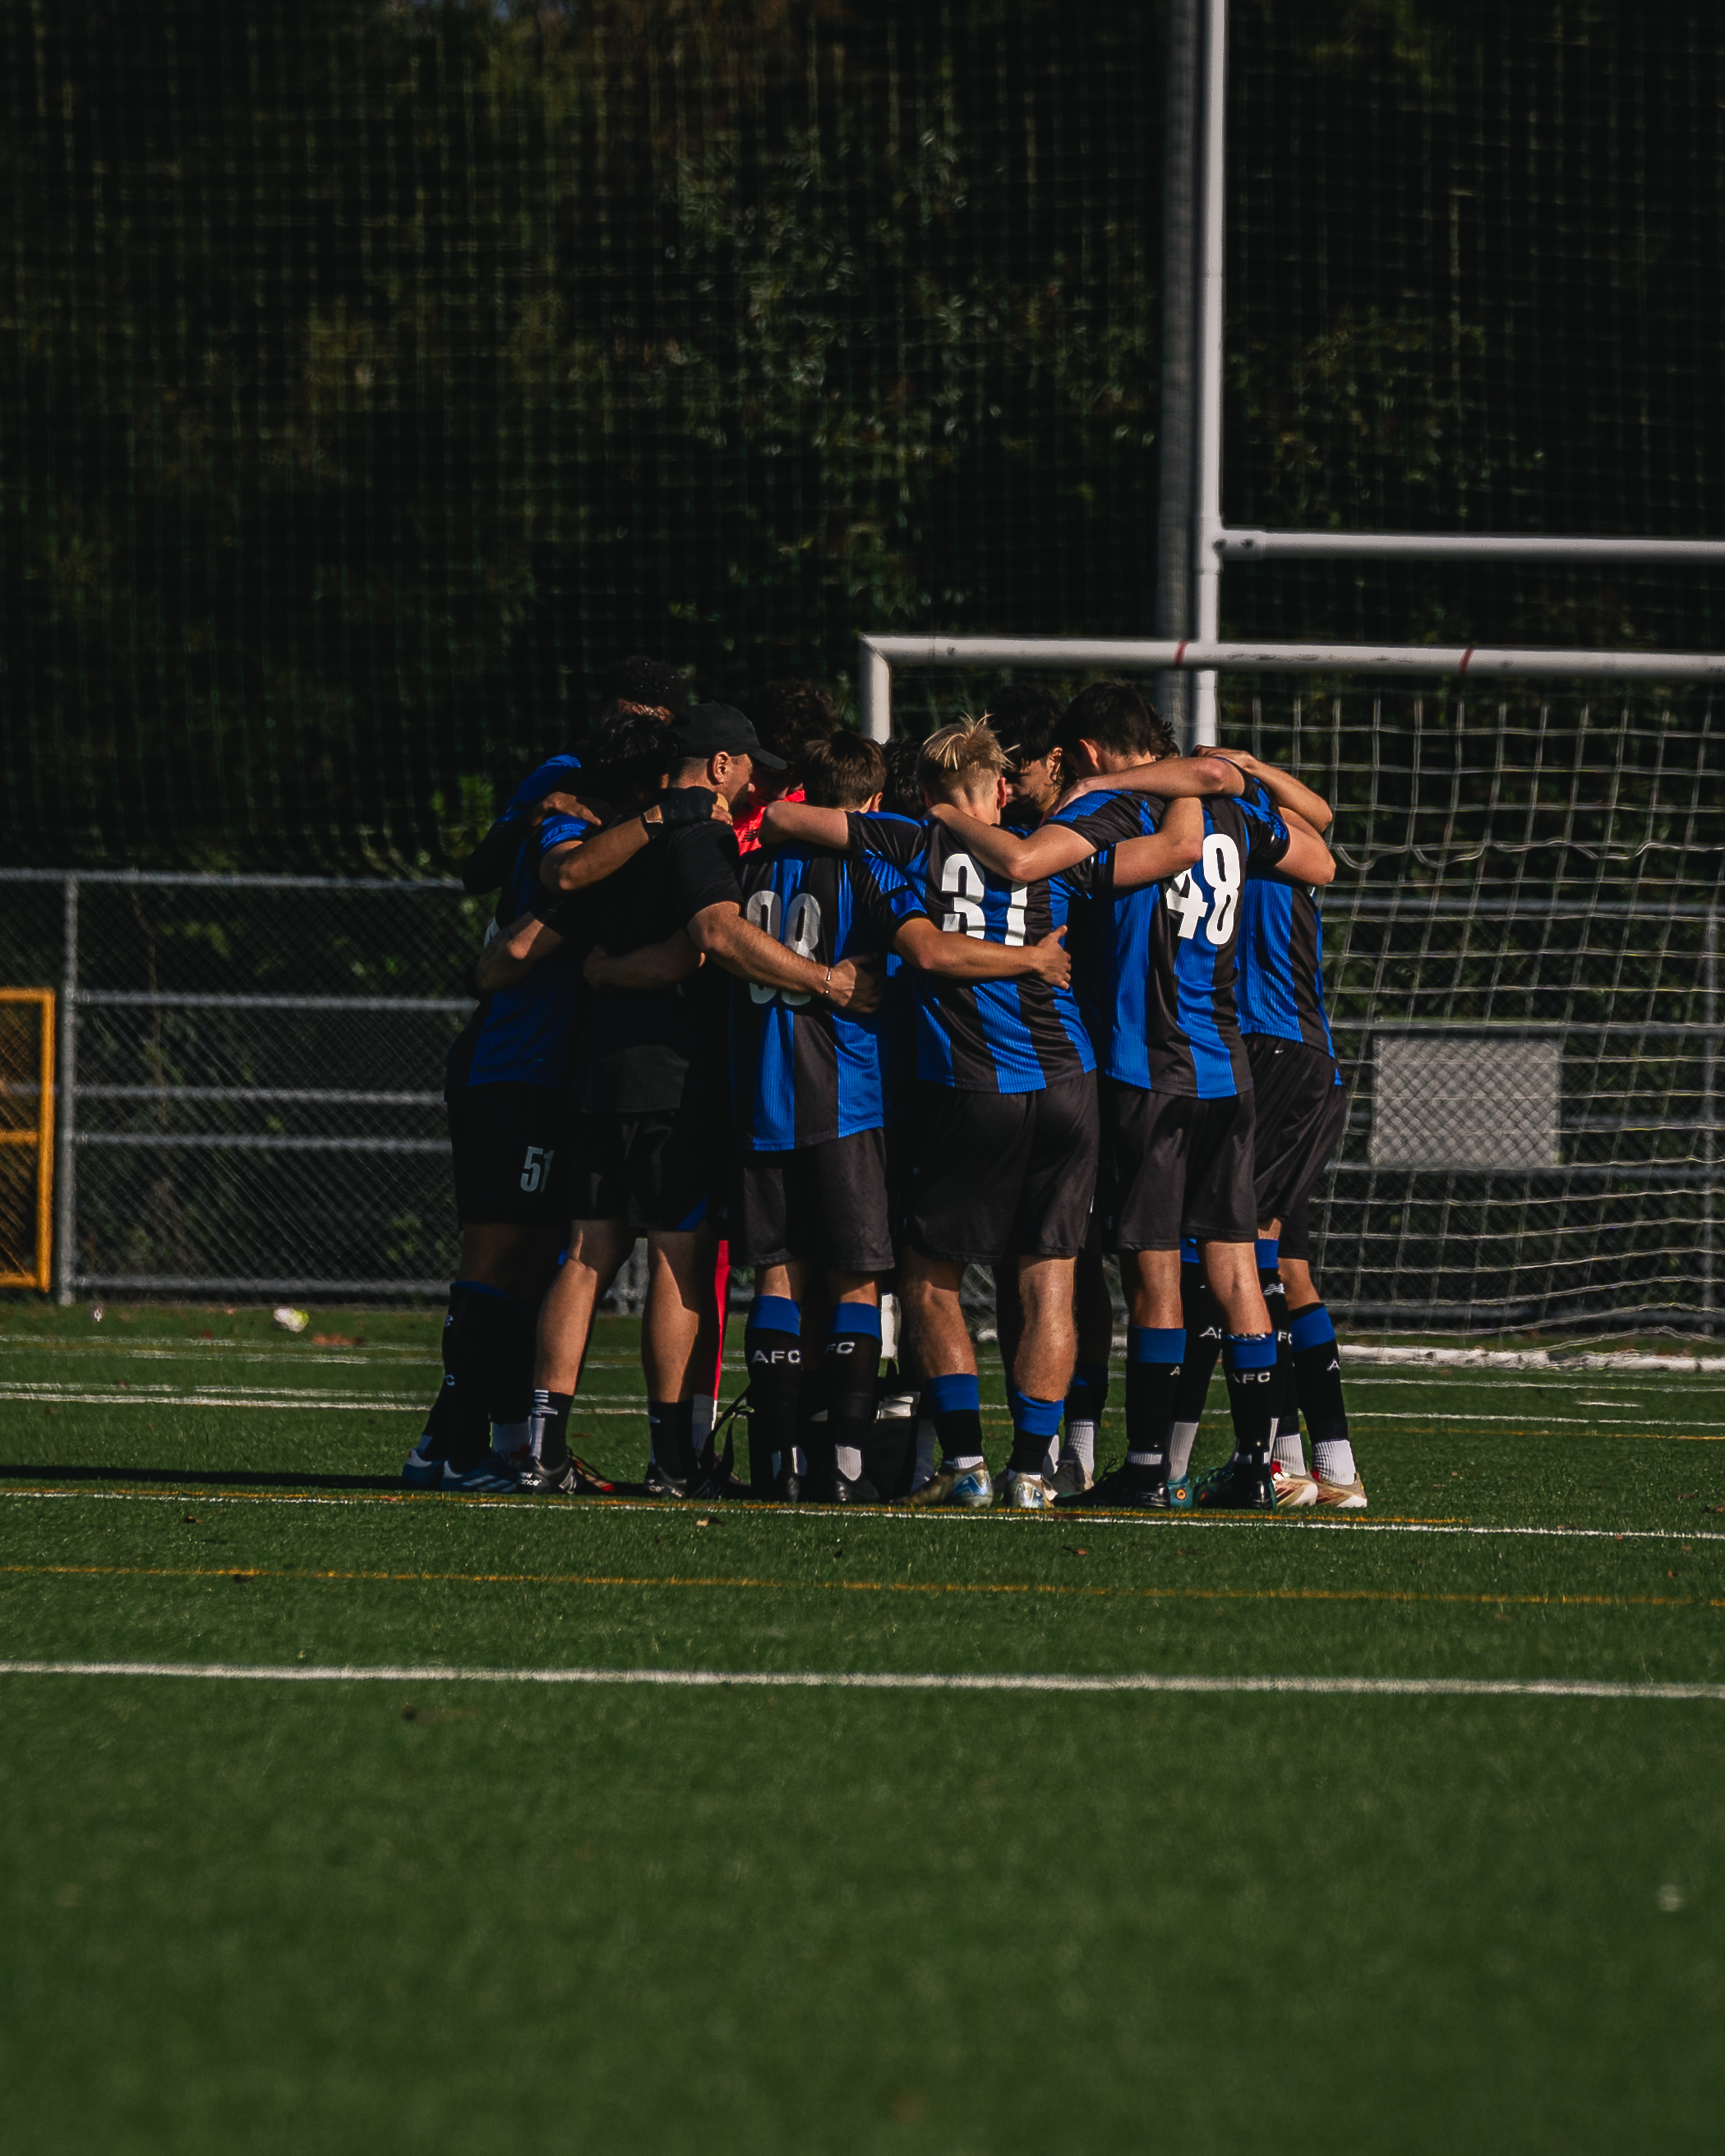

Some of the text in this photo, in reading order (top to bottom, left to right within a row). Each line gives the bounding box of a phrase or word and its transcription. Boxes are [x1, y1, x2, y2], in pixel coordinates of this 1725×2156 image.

[1165, 833, 1241, 945] 48
[520, 1145, 555, 1193] 51
[751, 1349, 801, 1365] AFC
